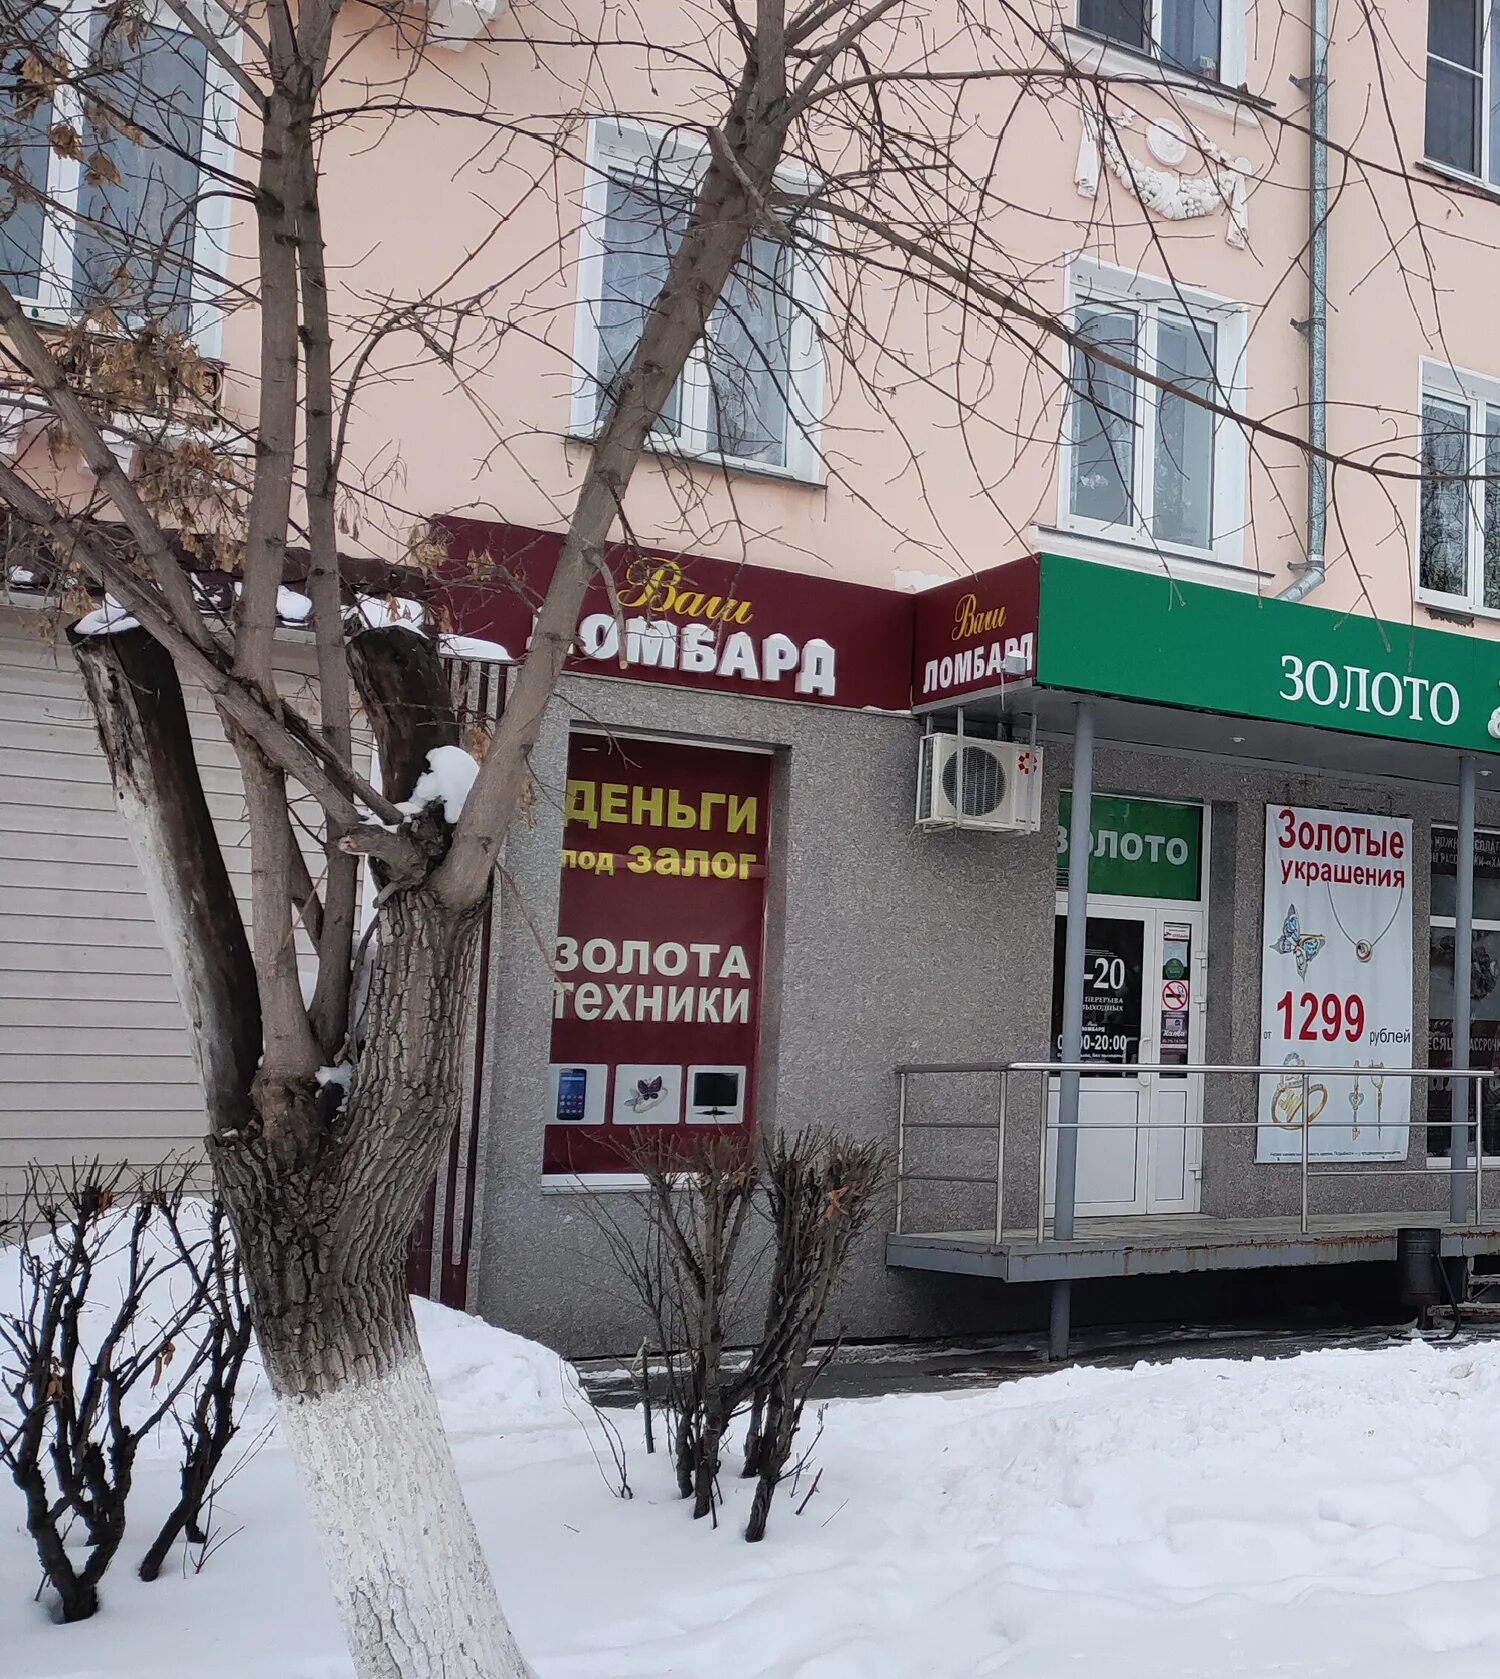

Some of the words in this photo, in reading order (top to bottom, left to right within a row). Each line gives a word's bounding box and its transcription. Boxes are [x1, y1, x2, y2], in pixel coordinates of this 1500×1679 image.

[617, 557, 753, 625] Ваш
[952, 594, 1006, 640] Ваш
[526, 606, 836, 697] ОМБАРД
[1280, 655, 1460, 726] ЗОЛОТО
[563, 779, 757, 835] ДЕНЬГИ
[1056, 825, 1189, 866] ЗЛОТО
[1278, 809, 1404, 859] Золотые
[561, 849, 614, 876] под
[1281, 858, 1405, 888] украшения
[555, 936, 750, 979] ЗОЛОТА
[1083, 958, 1125, 989] -20
[1264, 1031, 1272, 1040] от
[1369, 1029, 1411, 1044] рублей
[1277, 991, 1364, 1043] 1299
